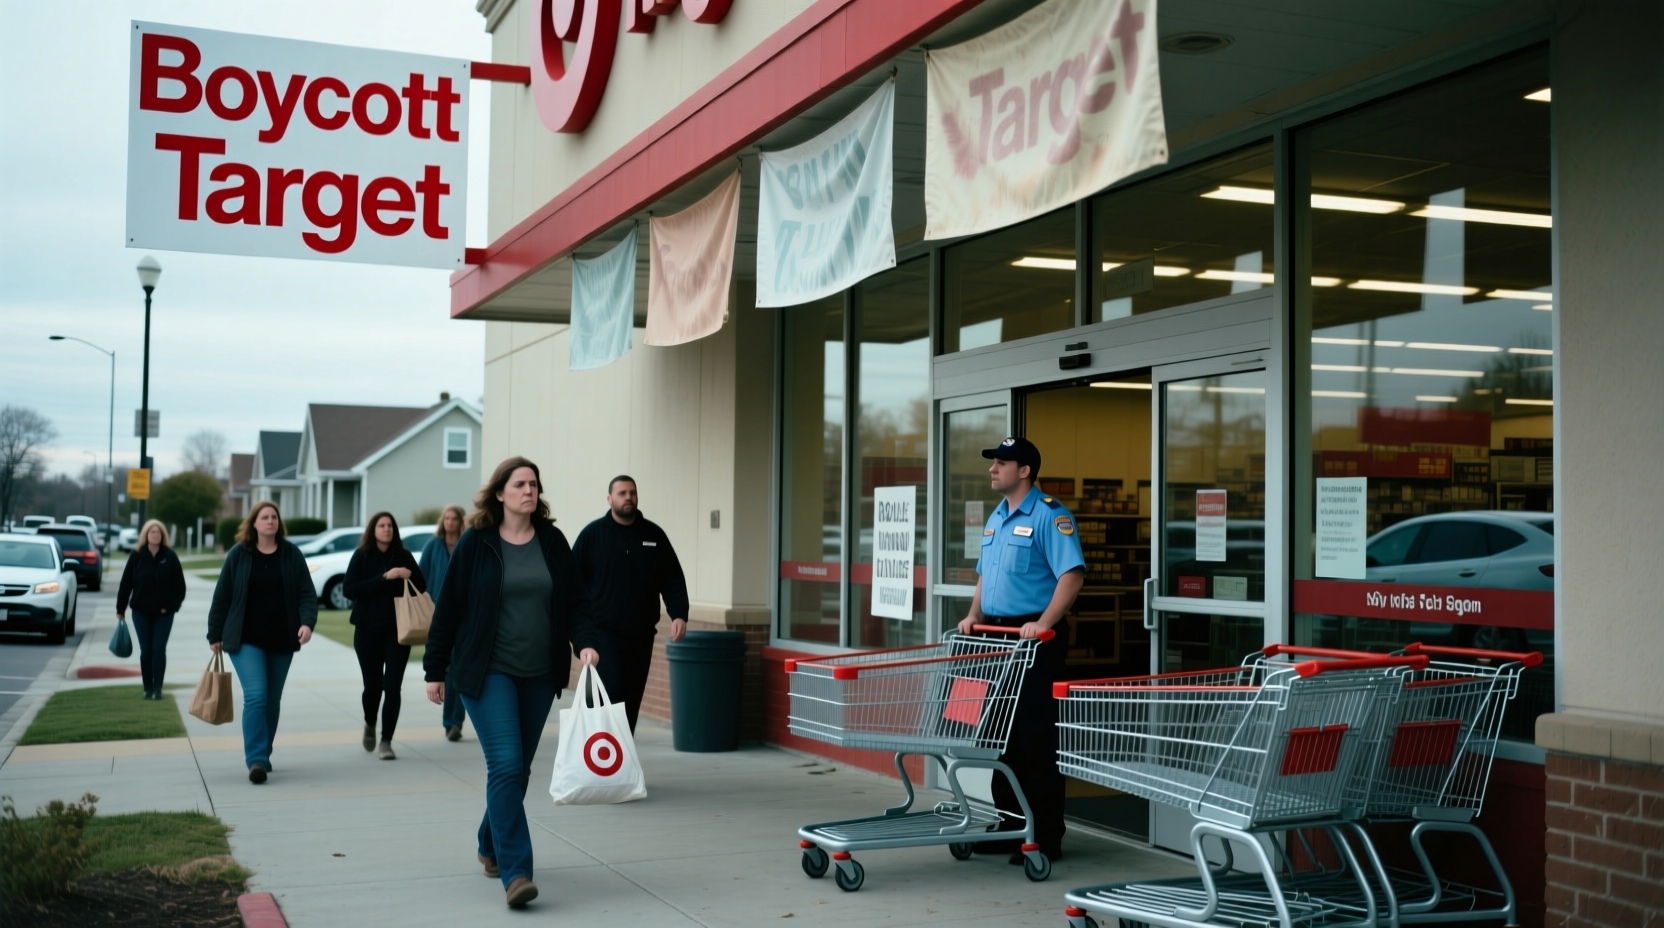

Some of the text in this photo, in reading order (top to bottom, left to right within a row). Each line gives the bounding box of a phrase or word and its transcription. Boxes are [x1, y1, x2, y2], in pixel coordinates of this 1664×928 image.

[140, 33, 461, 144] Boycott
[969, 0, 1145, 165] Target
[155, 133, 450, 254] Target
